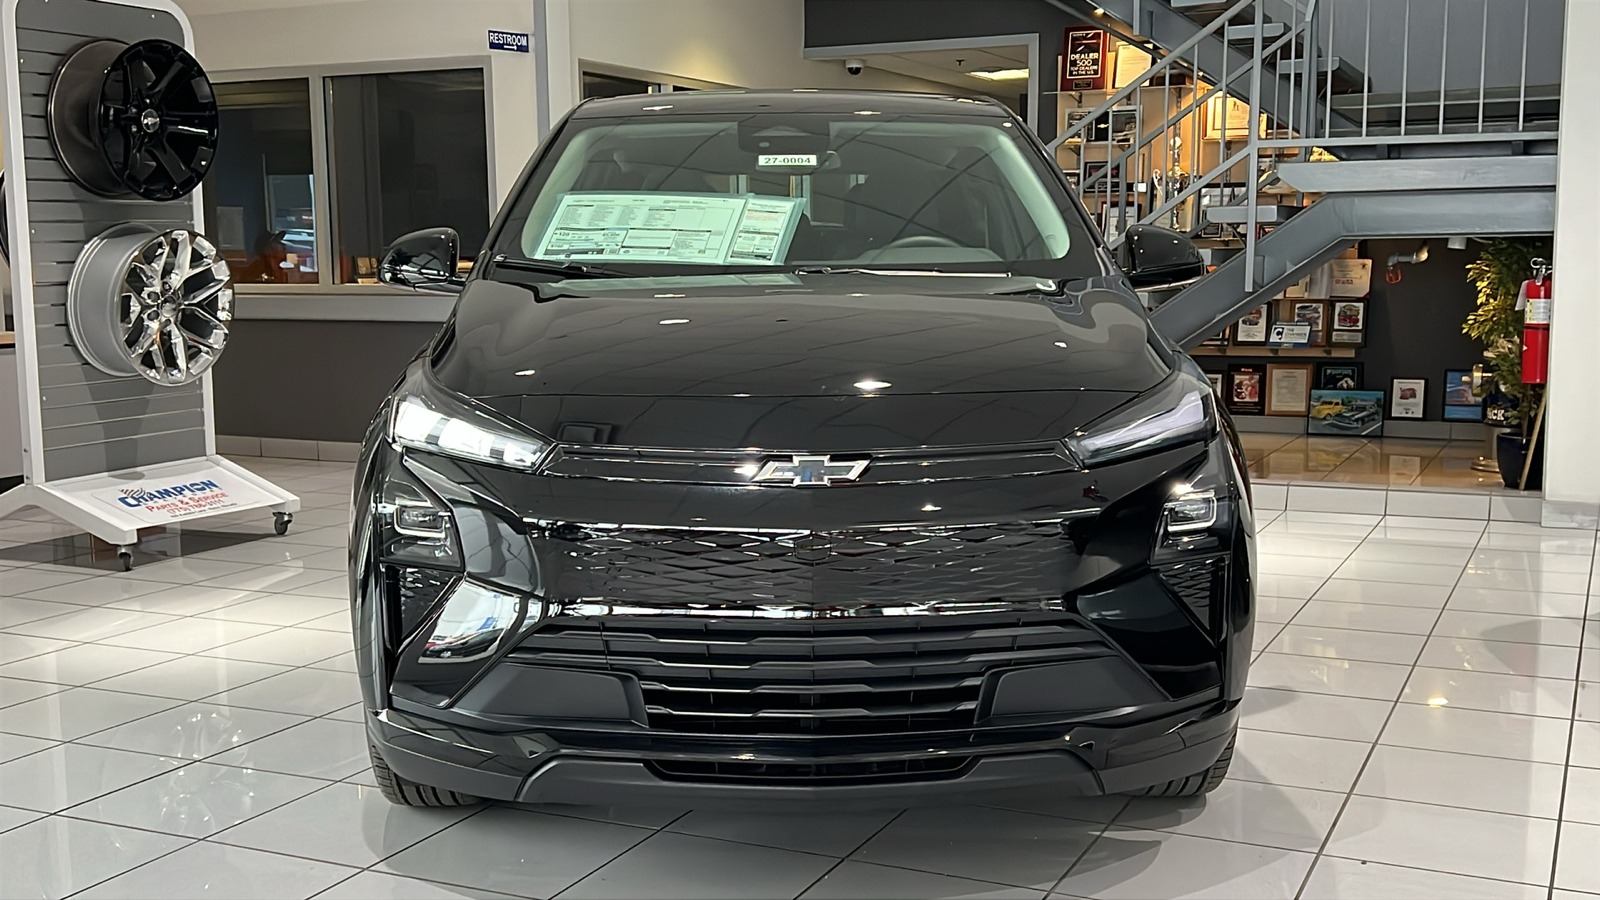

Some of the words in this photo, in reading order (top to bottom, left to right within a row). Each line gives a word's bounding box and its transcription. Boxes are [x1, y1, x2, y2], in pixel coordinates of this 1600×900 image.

[489, 32, 527, 46] RESTROOM
[118, 480, 219, 507] CHAMPION
[145, 502, 179, 512] PARTS
